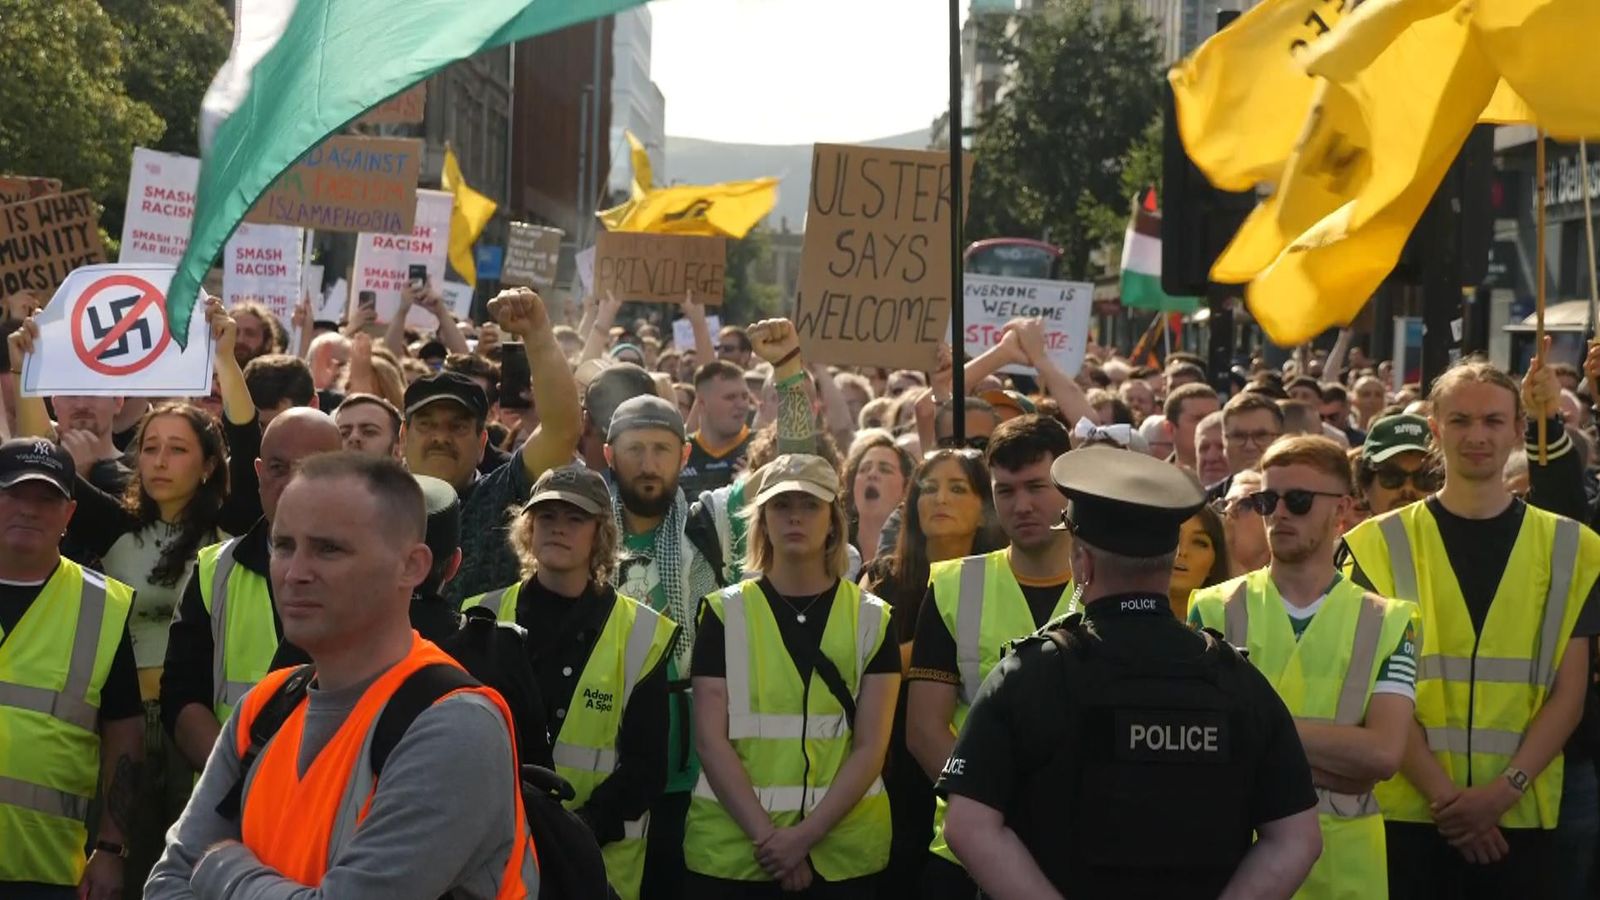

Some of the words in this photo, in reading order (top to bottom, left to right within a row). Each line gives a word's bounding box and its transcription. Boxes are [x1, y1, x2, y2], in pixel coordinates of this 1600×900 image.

[328, 146, 408, 176] AGAINST
[144, 185, 195, 204] SMASH
[4, 206, 29, 233] IS
[34, 193, 91, 226] WHAT
[132, 229, 171, 244] SMASH
[173, 236, 188, 246] TH
[373, 235, 433, 254] RACISM
[133, 241, 156, 254] FAR
[159, 245, 185, 257] RIGH
[236, 248, 282, 261] SMASH
[828, 229, 928, 283] SAYS
[235, 262, 286, 277] RACISM
[364, 266, 406, 279] SMASH
[599, 256, 723, 297] PRIVILEGE
[365, 279, 389, 290] FAR
[965, 283, 1038, 300] EVERYONE
[1059, 287, 1076, 302] IS
[267, 294, 287, 305] THE
[796, 289, 947, 343] WELCOME
[982, 298, 1066, 321] WELCOME
[965, 323, 1002, 346] STO
[1121, 599, 1156, 611] POLICE
[585, 699, 594, 709] A
[1130, 724, 1218, 751] POLICE
